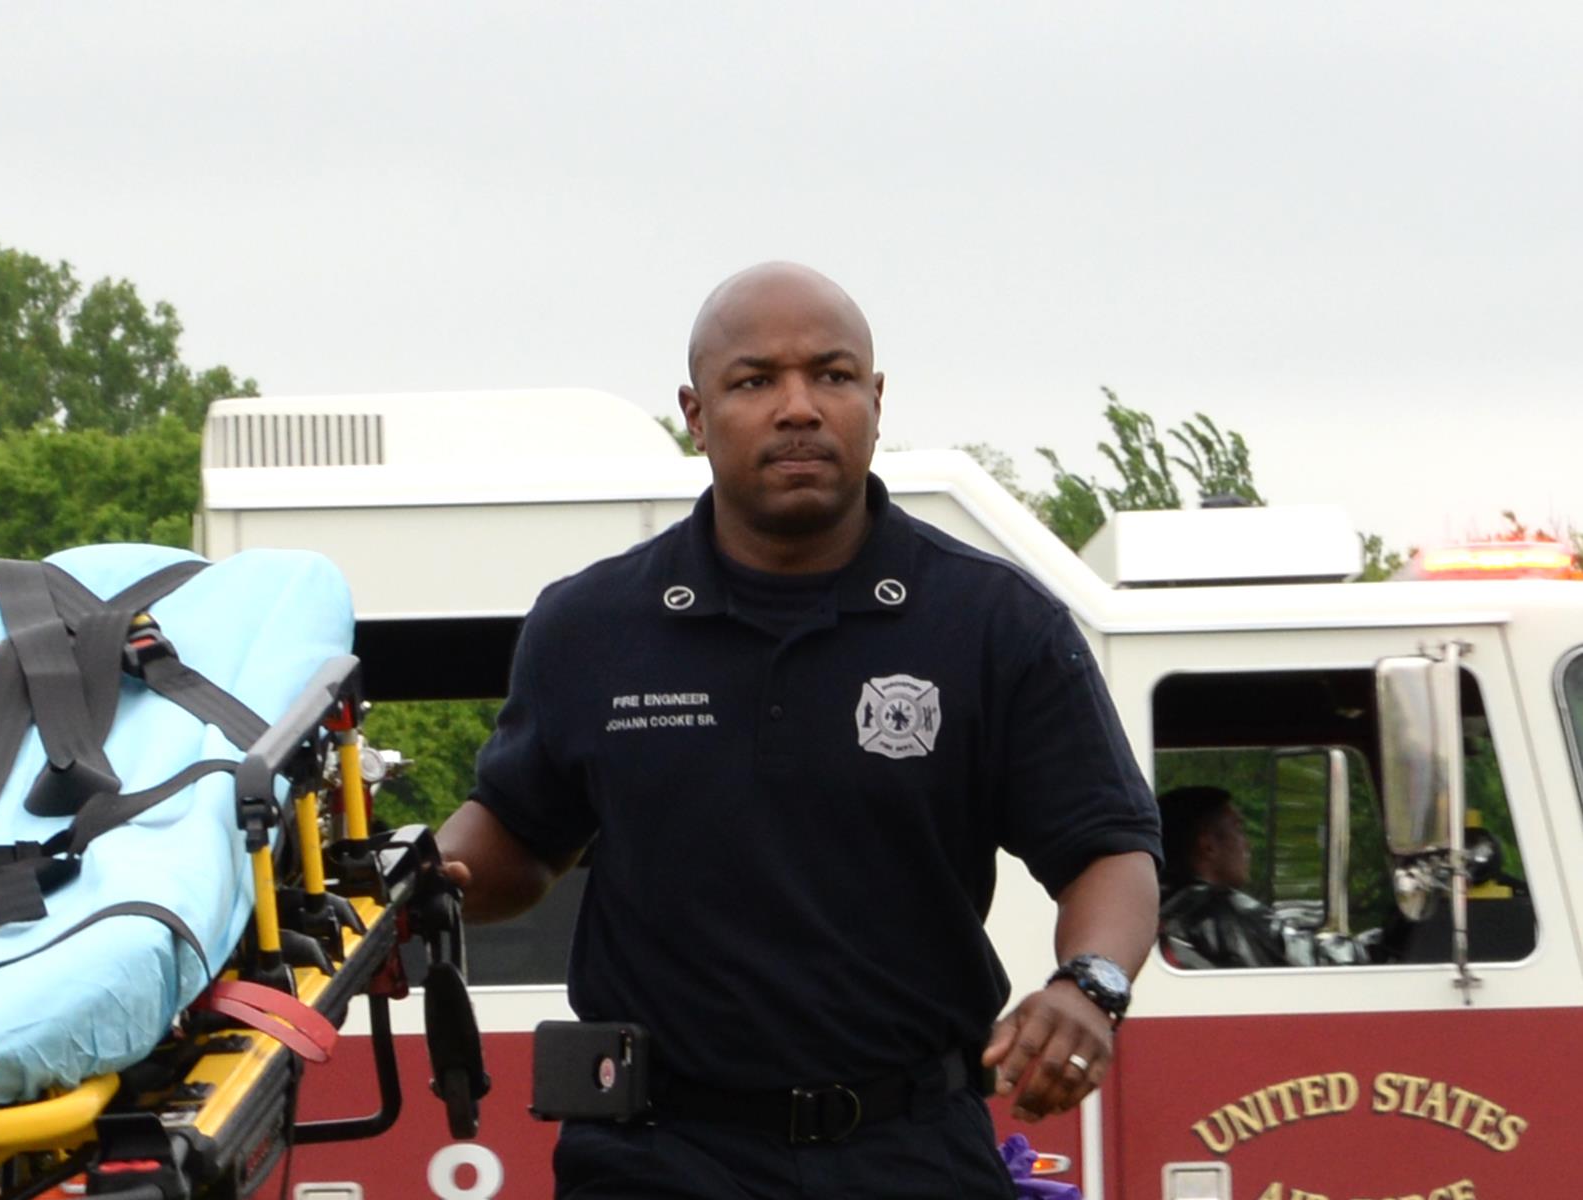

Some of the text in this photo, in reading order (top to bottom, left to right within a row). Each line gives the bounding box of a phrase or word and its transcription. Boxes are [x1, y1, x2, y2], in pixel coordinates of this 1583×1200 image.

[613, 693, 709, 709] FIRE ENGINEER
[650, 714, 695, 728] COOKE
[1191, 1071, 1528, 1153] UNITED STATES
